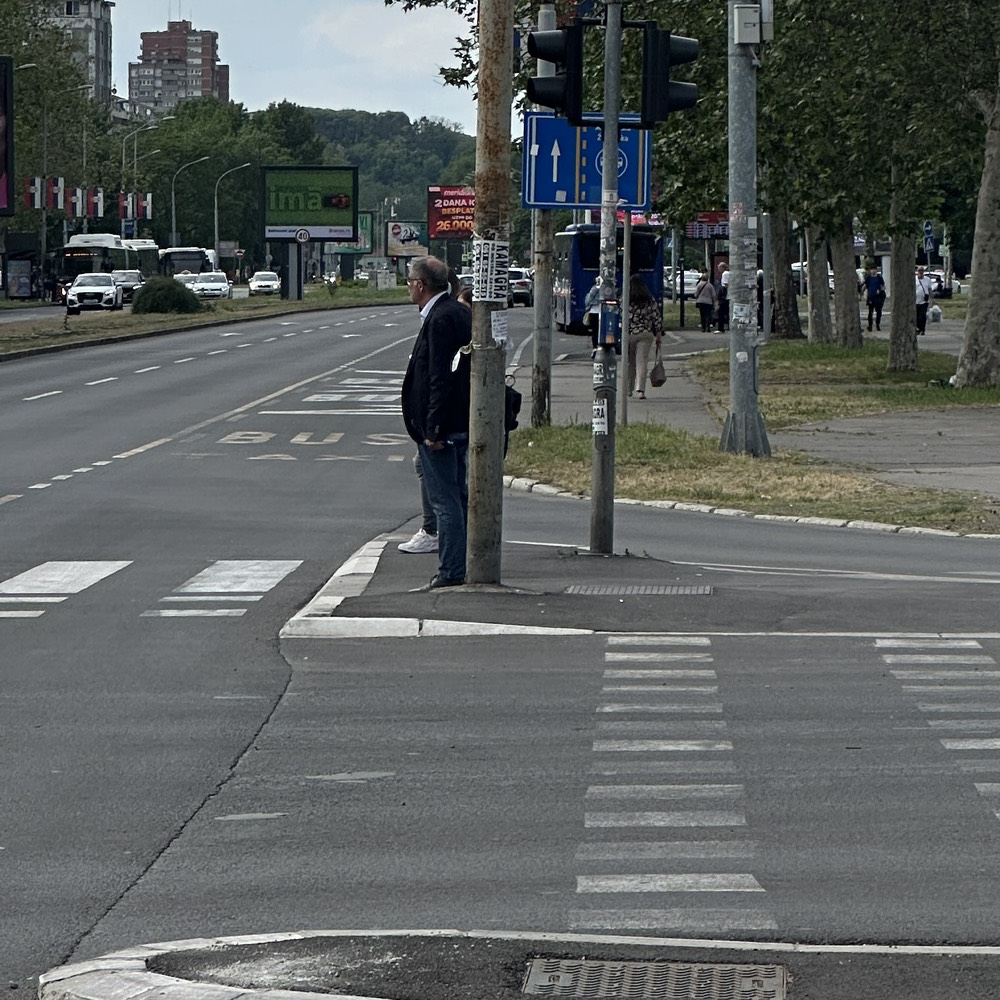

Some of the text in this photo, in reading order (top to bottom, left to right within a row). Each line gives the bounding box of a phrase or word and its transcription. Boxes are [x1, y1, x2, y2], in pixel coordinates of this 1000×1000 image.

[434, 199, 442, 207] 2
[298, 232, 308, 240] 40
[493, 244, 509, 299] KAMAGRA
[215, 431, 409, 445] BUS
